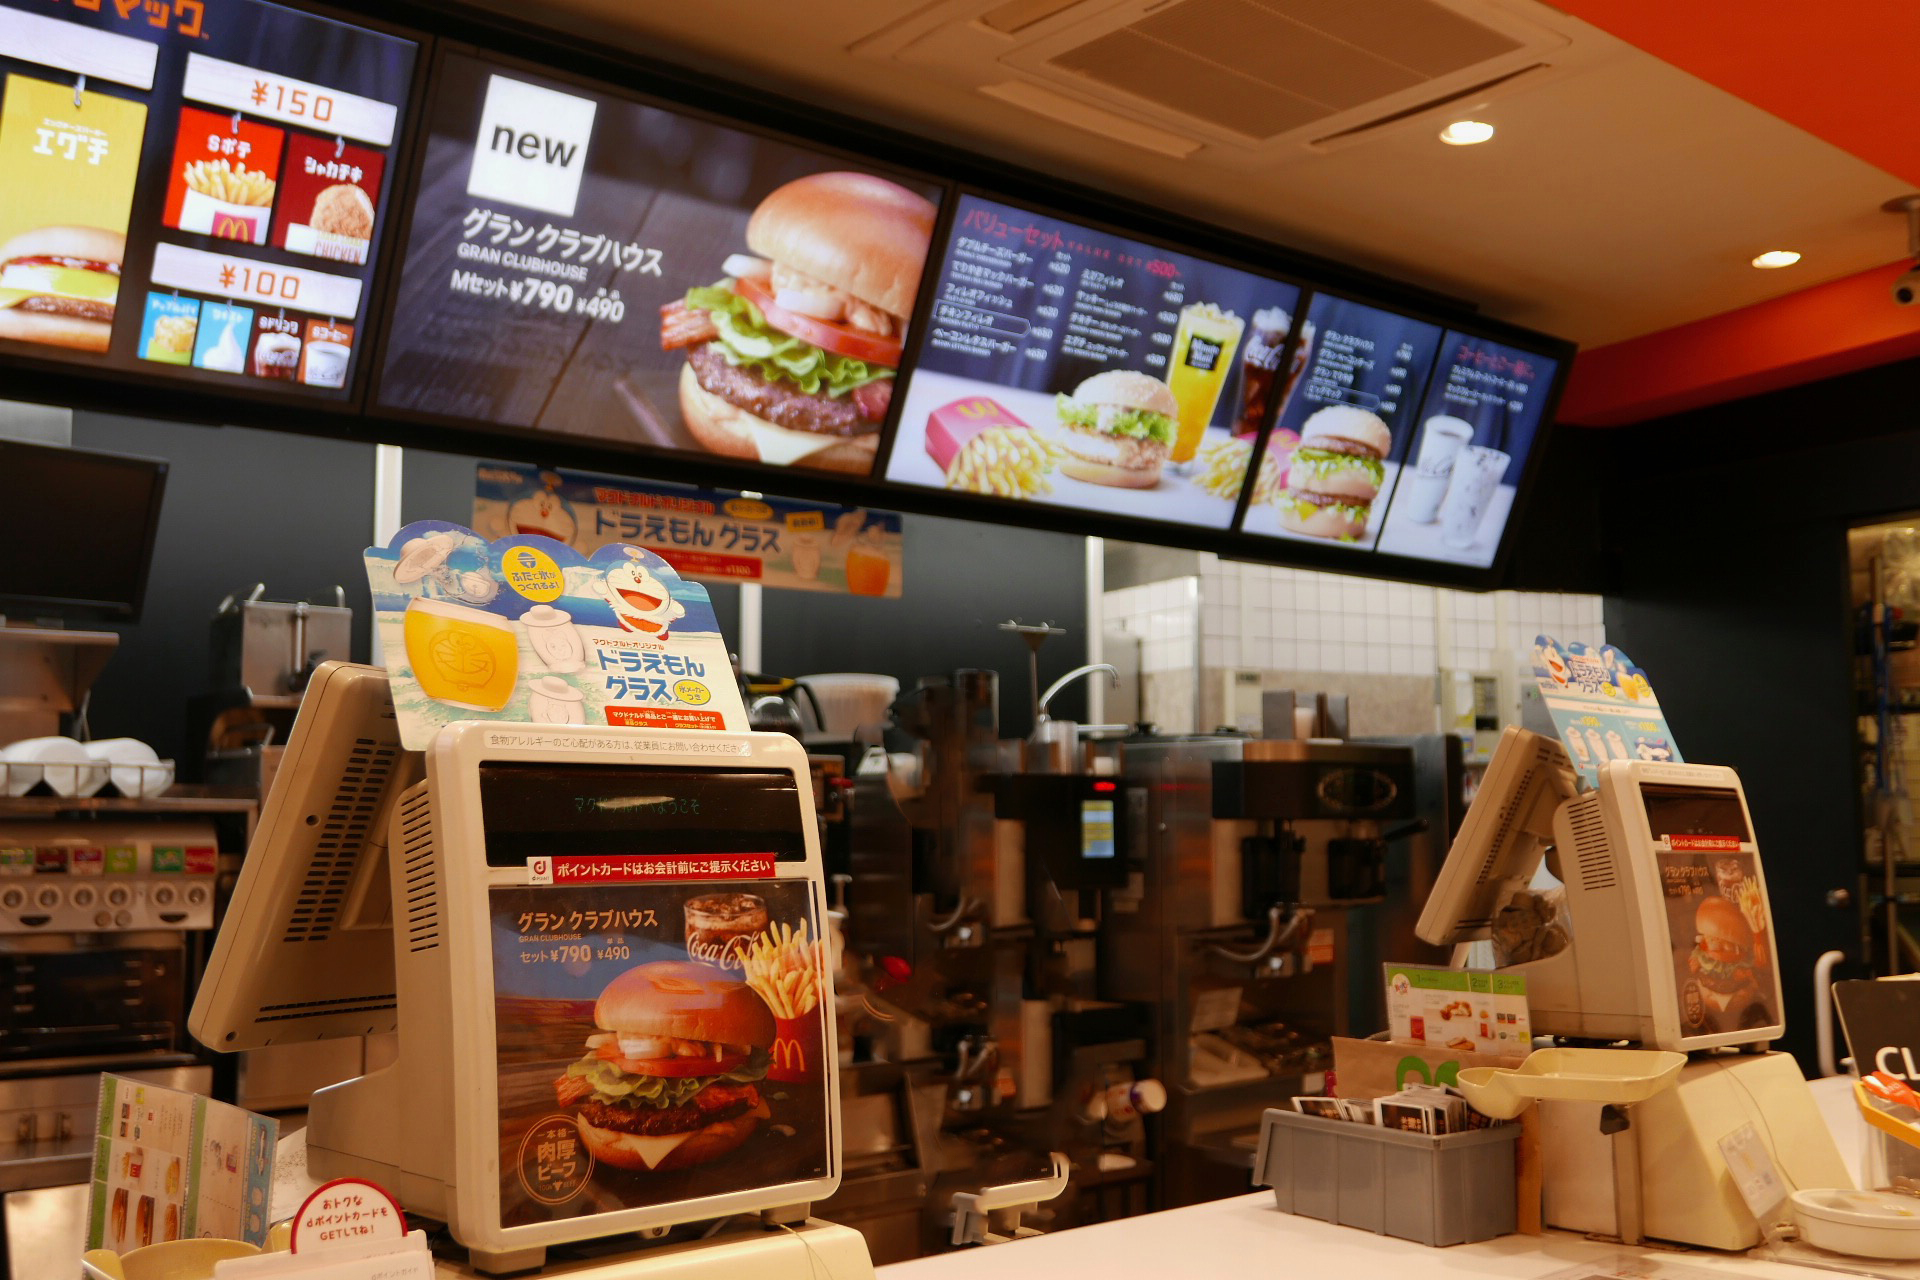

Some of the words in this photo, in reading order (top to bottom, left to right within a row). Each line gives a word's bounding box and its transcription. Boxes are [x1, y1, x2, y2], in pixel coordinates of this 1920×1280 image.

[251, 80, 334, 122] ¥150
[33, 128, 109, 165] エグチ
[207, 134, 252, 158] Sポテ
[491, 124, 579, 168] new
[463, 208, 534, 246] グラン
[536, 224, 663, 277] クラブハウス
[457, 242, 500, 264] GRAN
[501, 252, 588, 281] CLUBHOUSE
[219, 264, 300, 300] ¥100
[576, 295, 625, 322] ¥490
[596, 510, 714, 548] ドラえもん
[719, 525, 783, 553] グラス
[597, 649, 705, 678] ドラえもん
[605, 676, 673, 702] グラス
[557, 859, 770, 878] ポイントカードはお会計前にご提示ください
[518, 912, 565, 933] グラン
[569, 908, 659, 931] クラブハウス
[540, 933, 582, 942] CLUBHOUSE
[520, 950, 549, 963] セット
[551, 944, 592, 963] ¥790
[597, 945, 630, 961] ¥490
[537, 1139, 576, 1163] 肉厚
[538, 1161, 576, 1181] ビーフ
[323, 1195, 363, 1210] おトクな
[306, 1207, 388, 1228] dポイントカードを
[320, 1225, 375, 1241] GETしてね!
